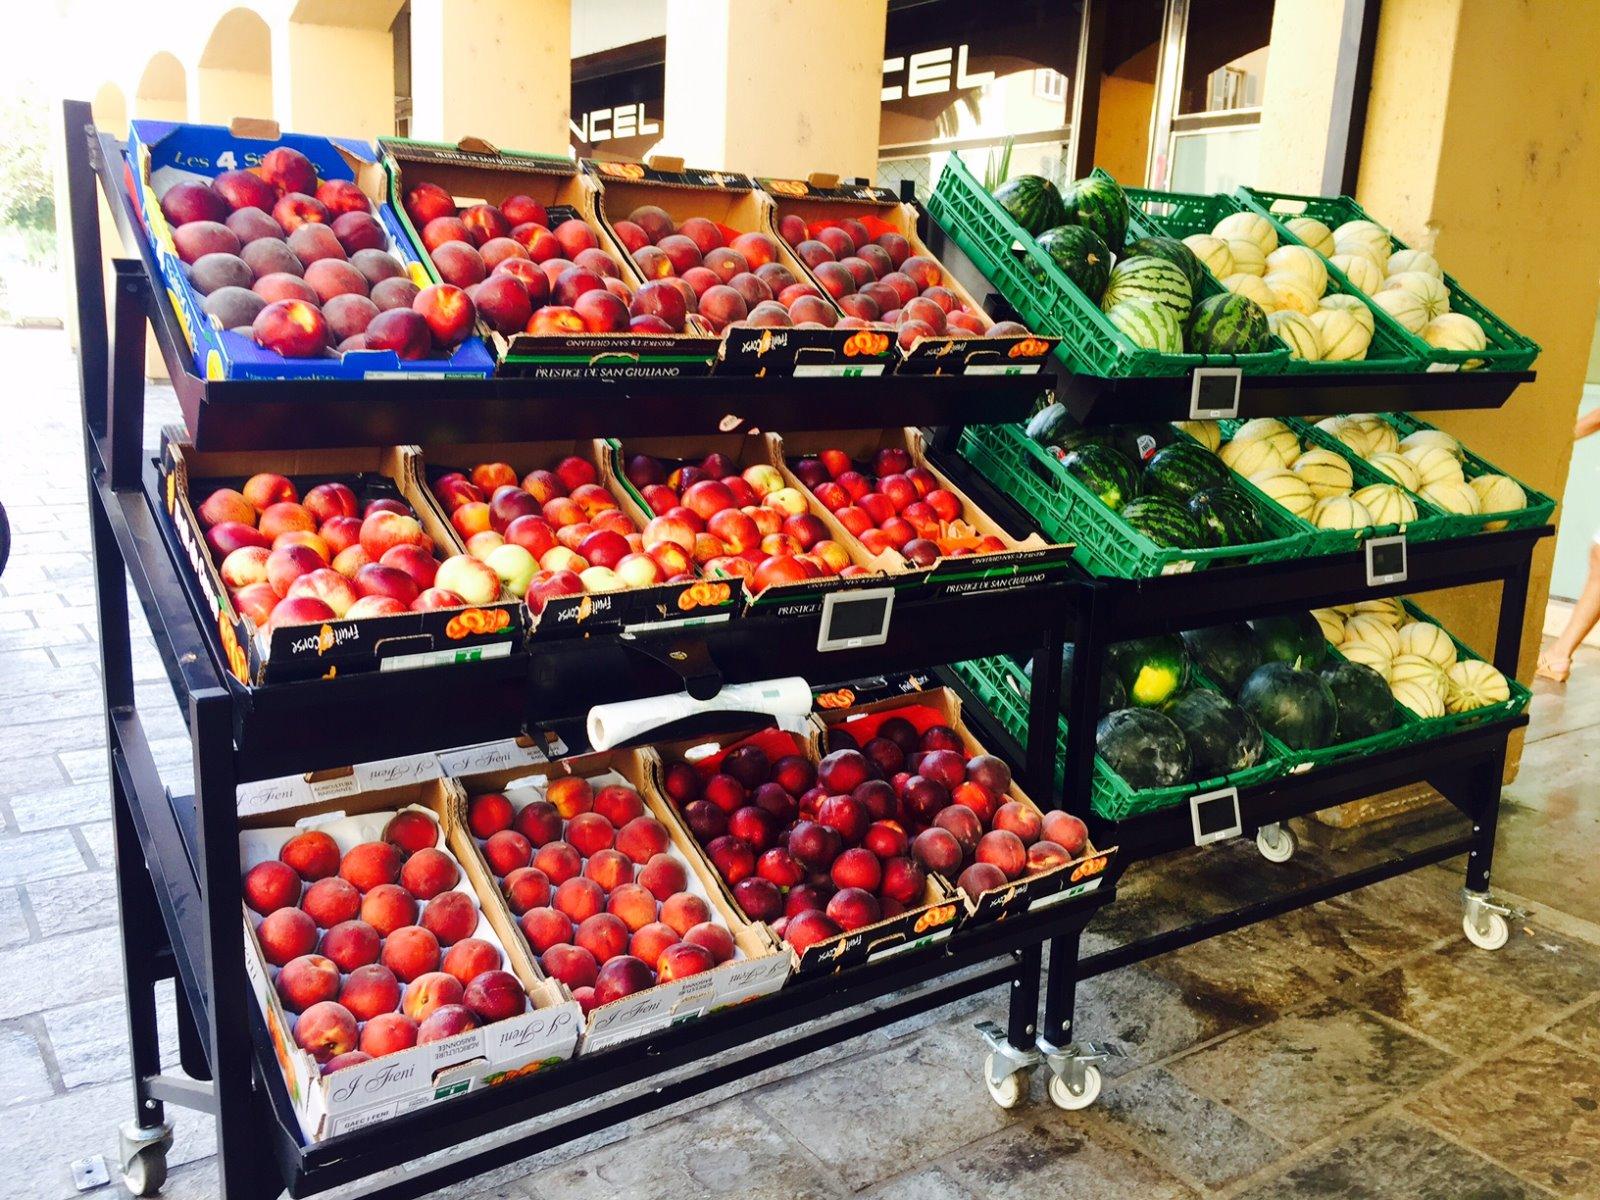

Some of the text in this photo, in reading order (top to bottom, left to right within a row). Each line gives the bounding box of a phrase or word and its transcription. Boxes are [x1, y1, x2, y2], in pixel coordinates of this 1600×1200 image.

[174, 151, 210, 168] Les
[216, 151, 238, 171] 4
[600, 368, 624, 377] SAN
[625, 367, 680, 377] GIULIANO
[990, 579, 1007, 588] SAN
[558, 606, 580, 622] Corse
[592, 596, 612, 614] Fruit
[332, 624, 360, 645] Fruit
[291, 636, 319, 654] Corse
